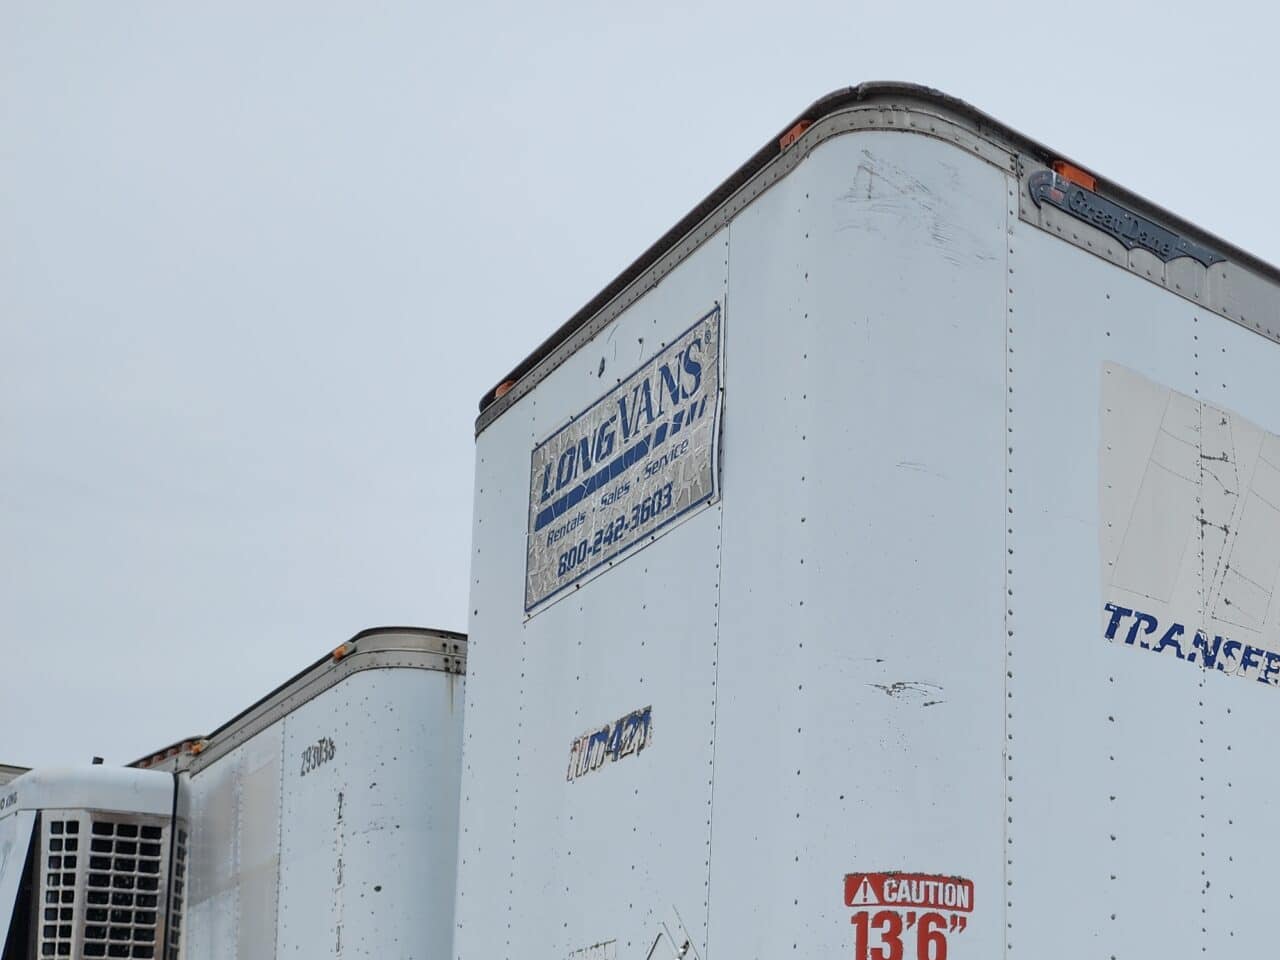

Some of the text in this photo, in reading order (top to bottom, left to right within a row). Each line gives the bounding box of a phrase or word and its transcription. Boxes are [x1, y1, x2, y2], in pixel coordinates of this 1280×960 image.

[547, 438, 690, 547] Rentals Sales Service
[557, 481, 674, 578] 800-242-3603
[883, 878, 969, 909] CAUTION
